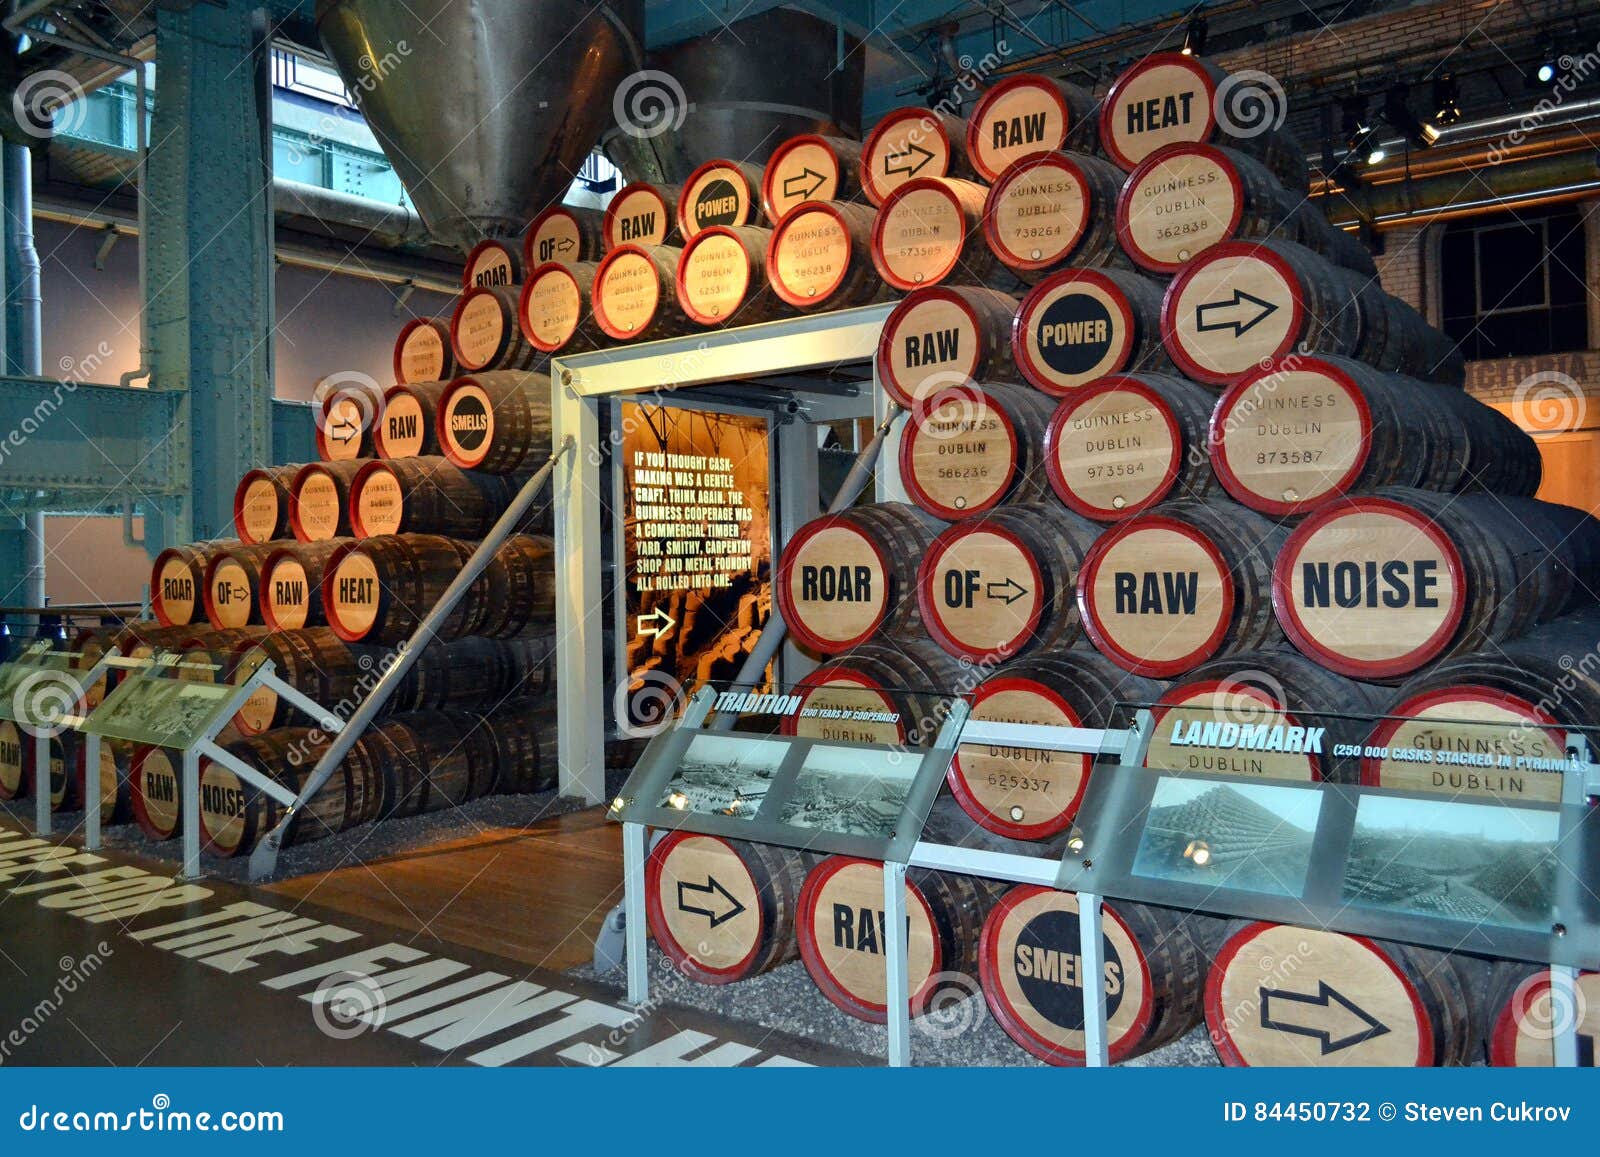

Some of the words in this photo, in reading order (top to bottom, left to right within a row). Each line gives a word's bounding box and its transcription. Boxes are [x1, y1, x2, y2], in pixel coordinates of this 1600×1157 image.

[1127, 91, 1194, 135] HEAT
[992, 112, 1047, 150] RAW
[1009, 182, 1072, 198] GUINNESS
[1143, 171, 1217, 198] GUINNESS
[697, 195, 737, 219] POWER
[1017, 203, 1062, 217] DUBLIN
[1155, 197, 1206, 216] DUBLIN
[620, 211, 656, 241] RAW
[788, 225, 838, 242] GUINNESS
[901, 225, 941, 238] DUBLIN
[1015, 225, 1061, 239] 738264
[1156, 220, 1208, 240] 362838
[539, 237, 556, 262] OF
[694, 250, 738, 264] GUINNESS
[794, 244, 830, 259] DUBLIN
[476, 264, 508, 288] ROAR
[701, 268, 732, 279] DUBLIN
[1042, 319, 1107, 348] POWER
[905, 327, 959, 368] RAW
[389, 414, 417, 440] RAW
[452, 414, 487, 431] SMELLS
[928, 418, 998, 434] GUINNESS
[1073, 409, 1154, 431] GUINNESS
[1257, 422, 1322, 437] DUBLIN
[938, 441, 987, 456] DUBLIN
[1085, 436, 1142, 453] DUBLIN
[634, 451, 644, 466] IF
[646, 452, 665, 467] YOU
[667, 453, 707, 470] THOUGHT
[709, 457, 734, 472] CASK-
[1256, 450, 1323, 465] 873587
[635, 469, 672, 486] MAKING
[674, 471, 694, 487] WAS
[696, 473, 702, 487] A
[704, 473, 734, 488] GENTLE
[937, 465, 988, 479] 586236
[1087, 462, 1145, 479] 973584
[669, 489, 696, 504] THINK
[728, 491, 743, 505] THE
[635, 505, 682, 520] GUINNESS
[684, 506, 734, 521] COOPERAGE
[735, 507, 753, 521] WAS
[636, 523, 642, 538] A
[645, 523, 705, 538] COMMERCIAL
[707, 524, 739, 538] TIMBER
[705, 540, 752, 555] CARPENTRY
[636, 558, 662, 574] SHOP
[665, 558, 683, 573] AND
[685, 557, 713, 572] METAL
[715, 556, 752, 571] FOUNDRY
[164, 578, 192, 601] ROAR
[276, 580, 303, 605] RAW
[339, 577, 373, 604] HEAT
[636, 576, 654, 592] ALL
[656, 575, 689, 591] ROLLED
[692, 574, 711, 588] INTO
[714, 573, 733, 587] ONE.
[801, 565, 872, 603] ROAR
[944, 569, 981, 609] OF
[1302, 559, 1439, 609] NOISE
[217, 581, 232, 605] OF
[1114, 571, 1199, 616] RAW
[713, 691, 803, 717] TRADITION
[819, 709, 841, 719] YEARS
[842, 710, 853, 720] OF
[822, 728, 873, 743] DUBLIN
[1169, 719, 1326, 754] LANDMARK
[1333, 743, 1361, 757] (250
[1364, 746, 1388, 759] 000
[1392, 748, 1433, 763] CASKS
[1436, 750, 1493, 768] STACKED
[1498, 754, 1513, 770] IN
[1413, 734, 1545, 759] GUINNESS
[1189, 754, 1263, 774] DUBLIN
[146, 772, 173, 802] RAW
[988, 773, 1051, 793] 625337
[1432, 771, 1525, 794] DUBLIN
[202, 783, 245, 819] NOISE
[7, 865, 215, 924] FOR
[126, 900, 364, 974] THE
[1015, 943, 1122, 997] SMELS
